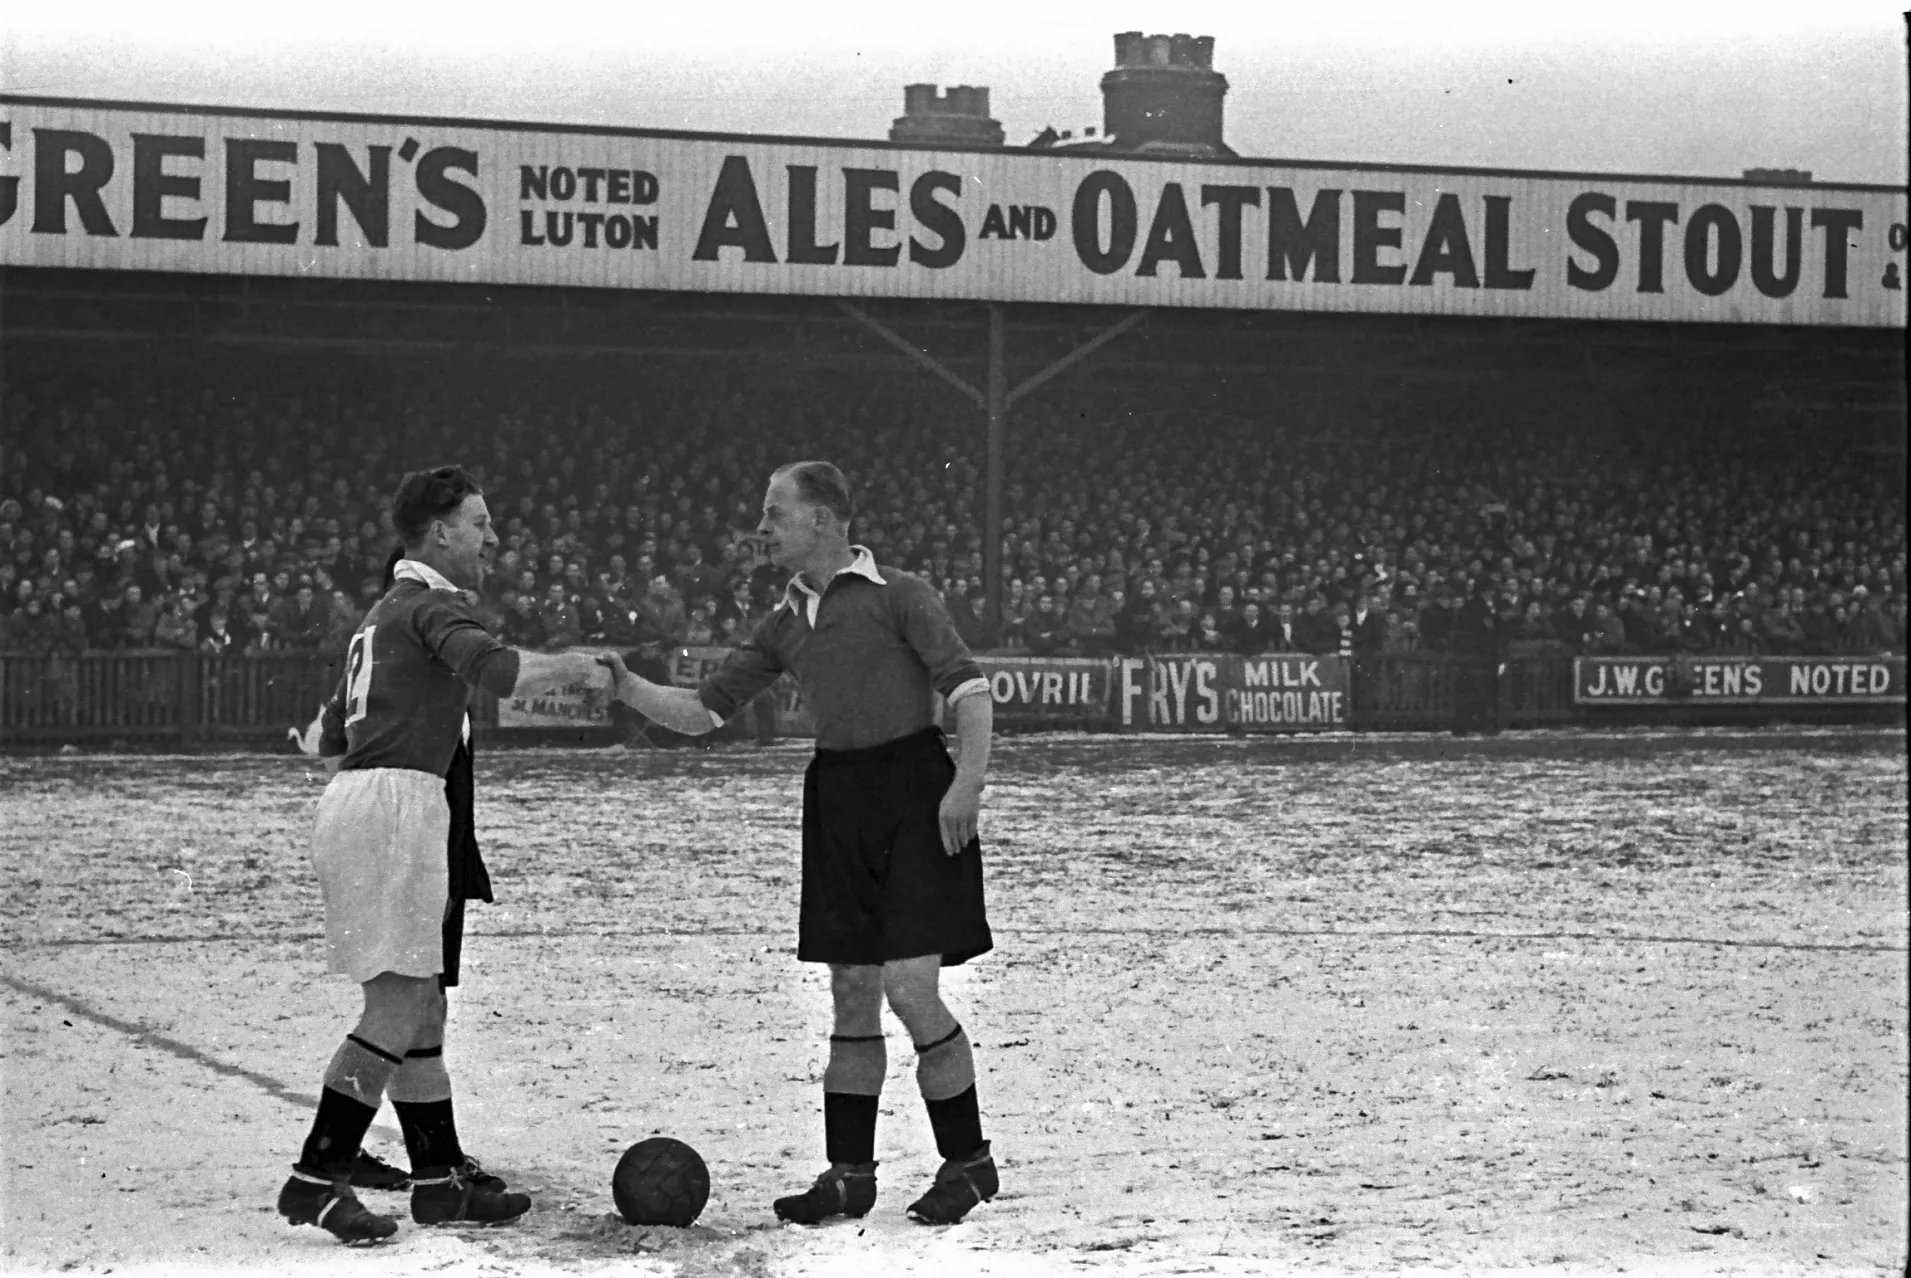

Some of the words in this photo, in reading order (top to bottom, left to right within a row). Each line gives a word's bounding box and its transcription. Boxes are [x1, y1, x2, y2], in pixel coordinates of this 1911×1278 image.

[0, 121, 488, 251] REEN'S
[520, 165, 660, 206] NOTED
[520, 210, 660, 250] LUTON
[692, 155, 967, 270] ALES
[979, 204, 1058, 242] AND
[1072, 169, 1538, 291] OATMEAL
[1566, 191, 1863, 300] STOUT
[990, 670, 1094, 704] OVRIL
[1122, 657, 1219, 725] FRY'S
[1244, 661, 1322, 687] MILK
[1790, 665, 1890, 695] NOTED
[1225, 689, 1343, 724] CHOCOLATE
